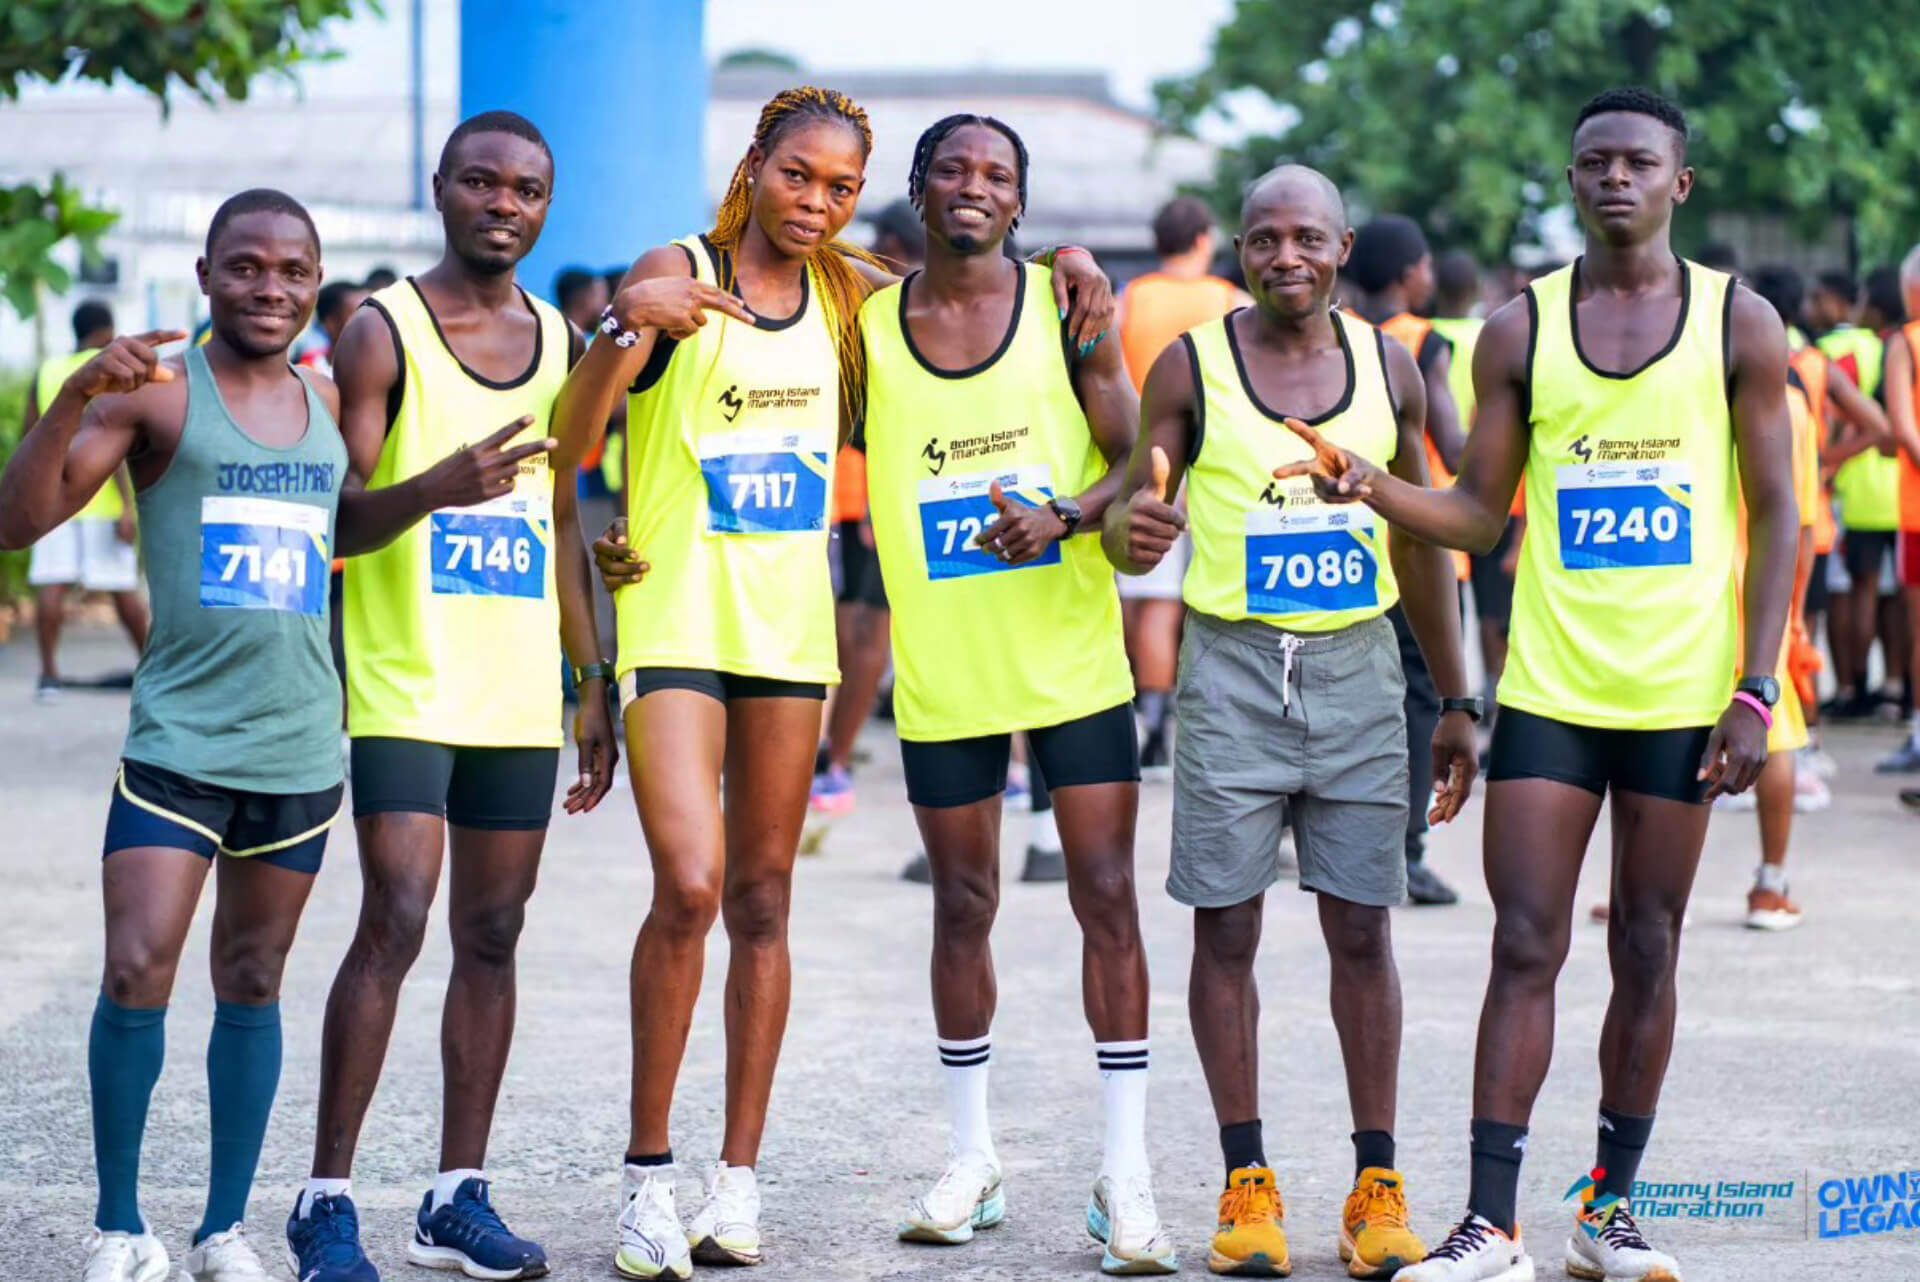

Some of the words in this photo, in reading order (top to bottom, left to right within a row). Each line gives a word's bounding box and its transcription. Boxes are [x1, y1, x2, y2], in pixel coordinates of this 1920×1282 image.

[748, 389, 785, 400] Bonny
[787, 387, 820, 397] Island
[950, 435, 989, 450] Bonny
[991, 427, 1029, 442] Island
[952, 441, 1016, 461] Marathon
[1597, 449, 1665, 460] Marathon
[1598, 439, 1638, 449] Bonny
[1641, 438, 1680, 448] Island
[218, 462, 299, 493] JOSEPH
[728, 473, 797, 510] 7117
[937, 513, 1000, 555] 72
[1571, 506, 1678, 545] 7240
[219, 543, 306, 588] 7141
[445, 534, 531, 574] 7146
[1260, 548, 1363, 590] 7086
